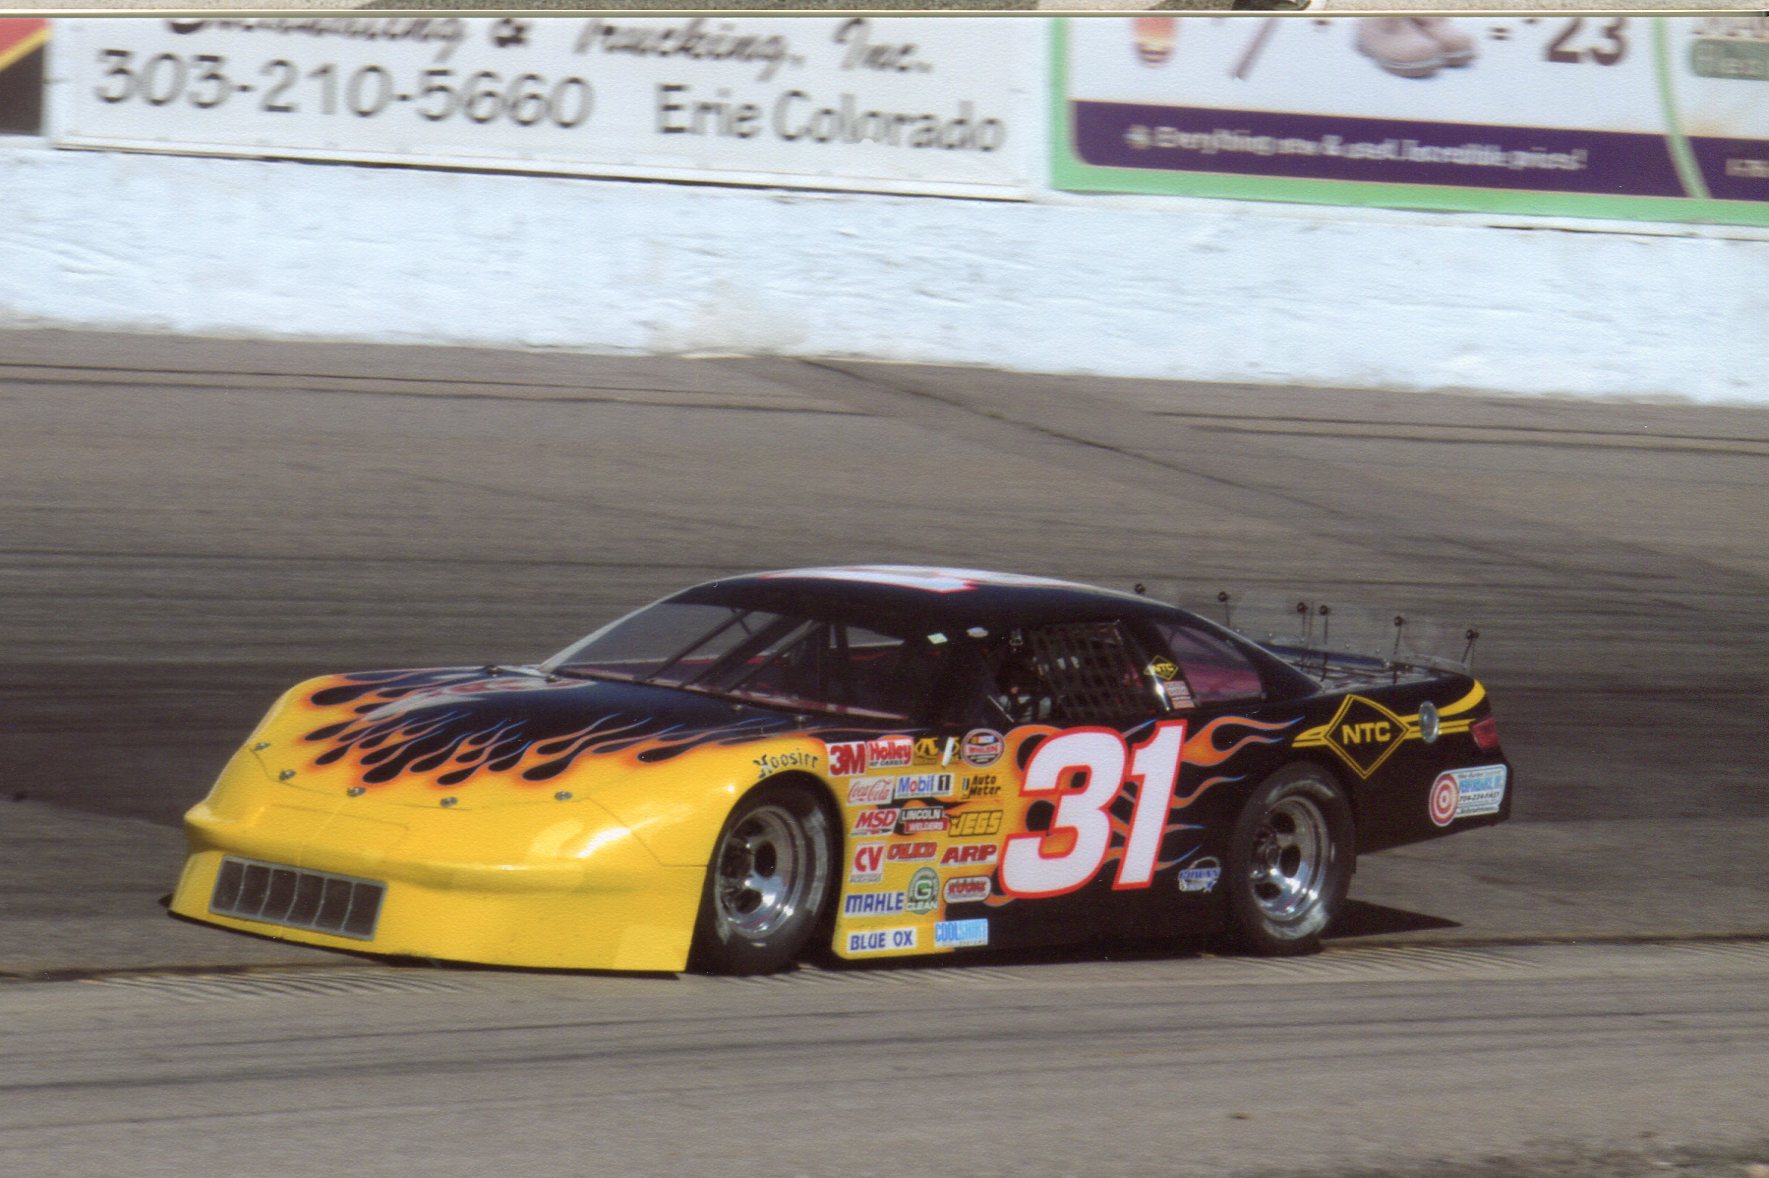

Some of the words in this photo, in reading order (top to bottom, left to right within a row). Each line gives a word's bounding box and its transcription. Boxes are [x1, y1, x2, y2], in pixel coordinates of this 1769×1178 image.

[94, 47, 594, 129] 303-210-5660
[655, 83, 761, 139] Erie
[771, 89, 1006, 153] Colorado
[1342, 722, 1392, 745] NTC
[830, 743, 866, 776] 3M
[867, 740, 912, 765] Holley
[897, 775, 935, 796] Mobil
[938, 774, 951, 792] 1
[972, 775, 997, 785] Auto
[966, 785, 1001, 798] Meter
[855, 809, 897, 830] MSD
[901, 807, 942, 820] LINCOLN
[1000, 719, 1188, 899] 31
[948, 810, 1003, 837] JEGS
[855, 845, 884, 873] CV
[940, 844, 997, 865] ARP
[844, 892, 905, 914] MAHLE
[907, 900, 938, 911] CLEAN
[850, 932, 886, 951] BLUE
[893, 929, 913, 947] OX
